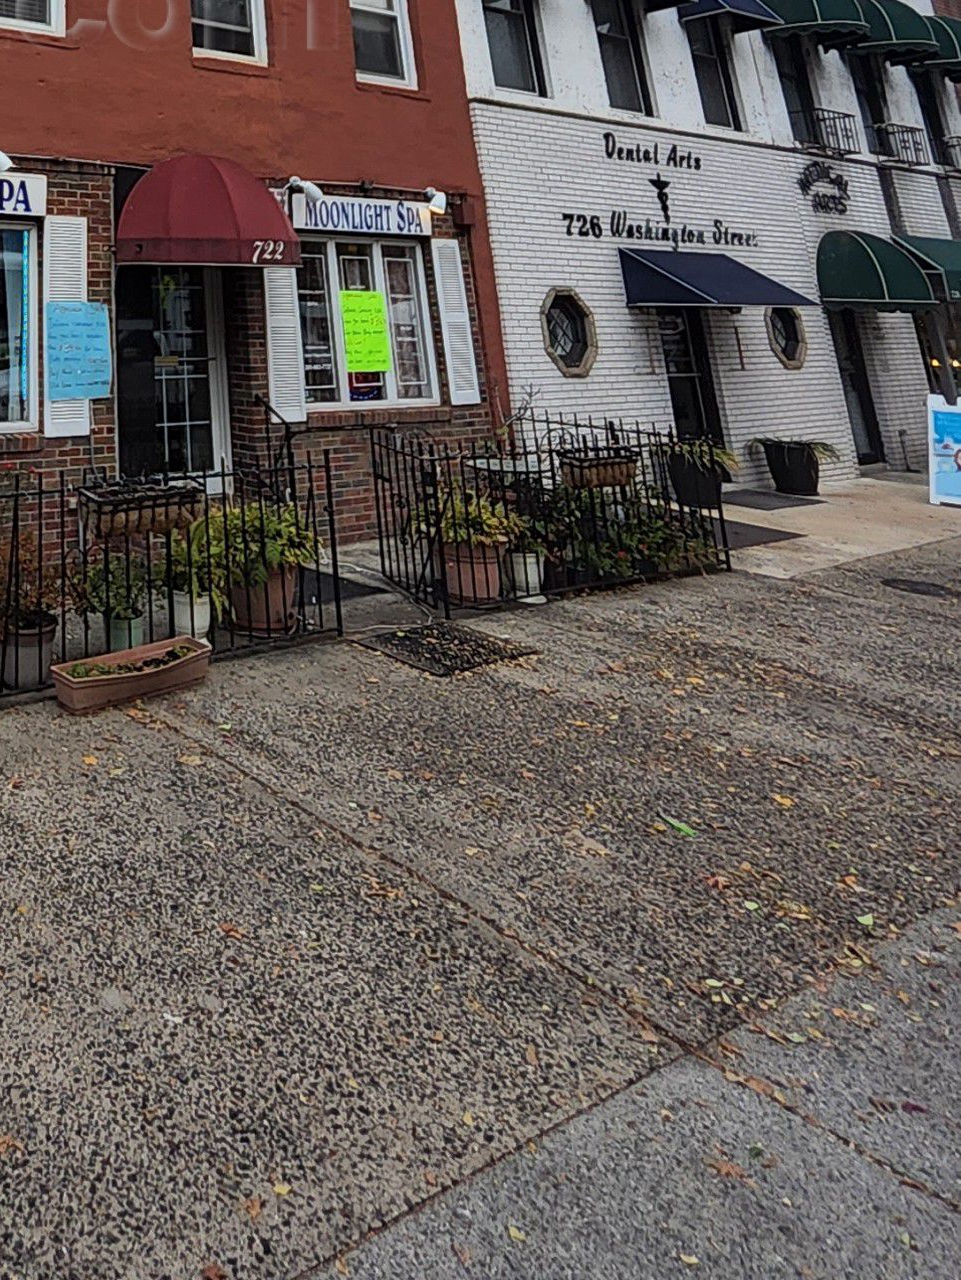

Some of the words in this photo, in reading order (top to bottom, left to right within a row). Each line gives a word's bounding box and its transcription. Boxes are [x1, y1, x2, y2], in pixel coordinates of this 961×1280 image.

[603, 132, 660, 165] Dental
[666, 144, 701, 170] Arts
[562, 213, 603, 238] 726
[610, 210, 706, 251] Washington
[252, 240, 284, 264] 722
